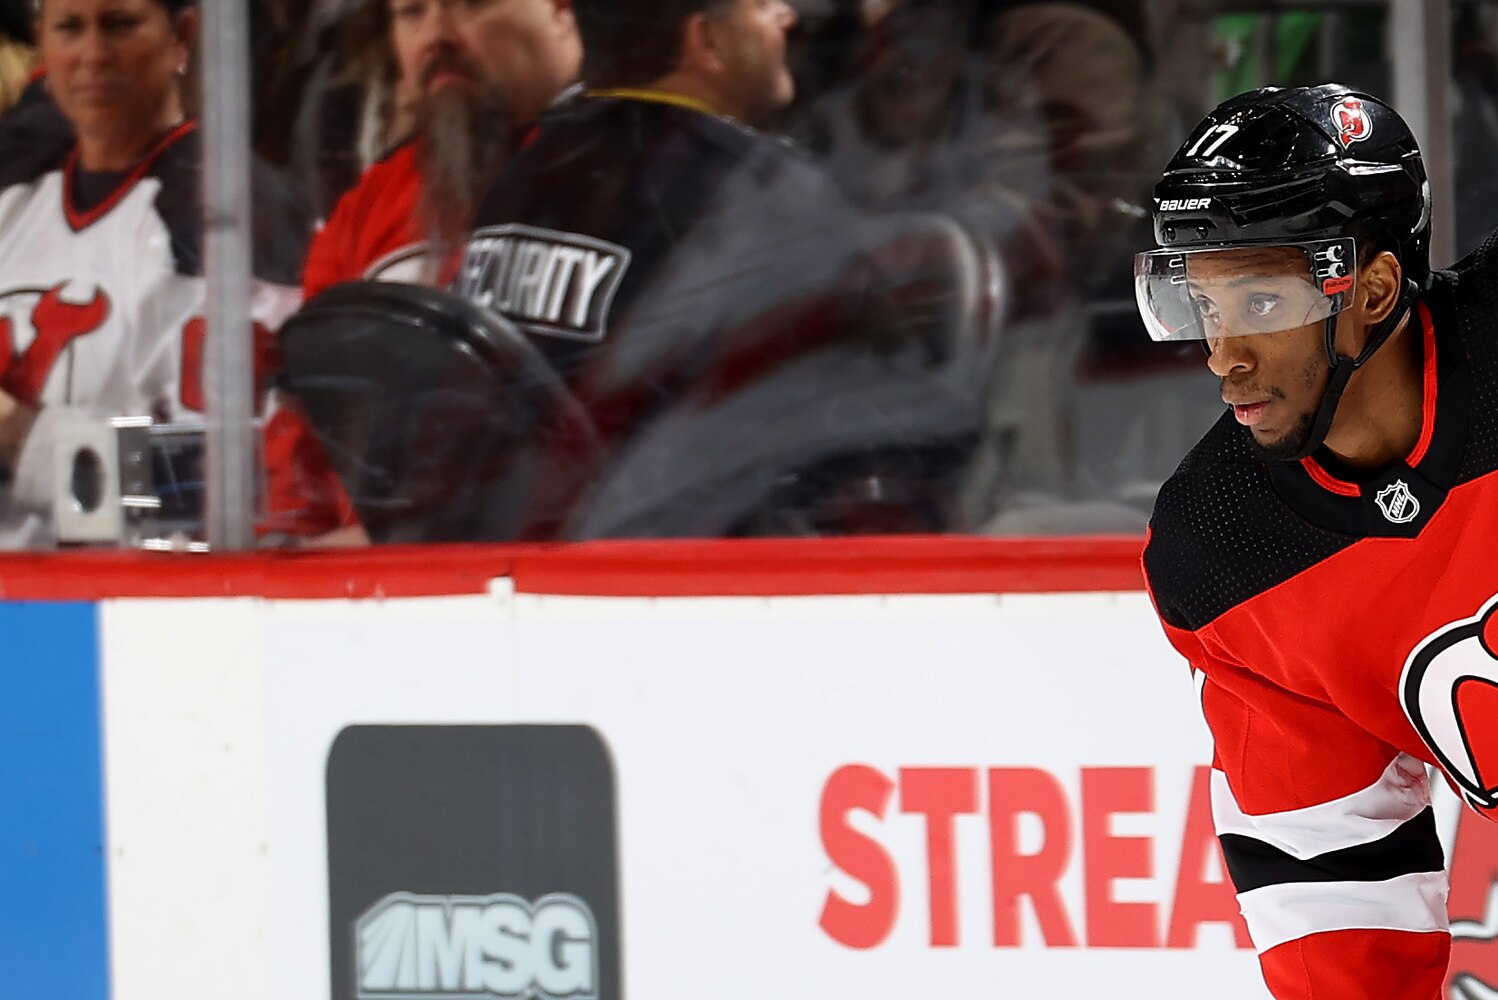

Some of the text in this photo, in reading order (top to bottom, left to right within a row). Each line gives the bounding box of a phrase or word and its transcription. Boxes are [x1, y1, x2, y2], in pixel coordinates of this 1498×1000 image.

[1186, 124, 1239, 157] 17
[459, 237, 615, 328] ECURITY
[818, 762, 1262, 950] STREA
[417, 896, 595, 998] MSG
